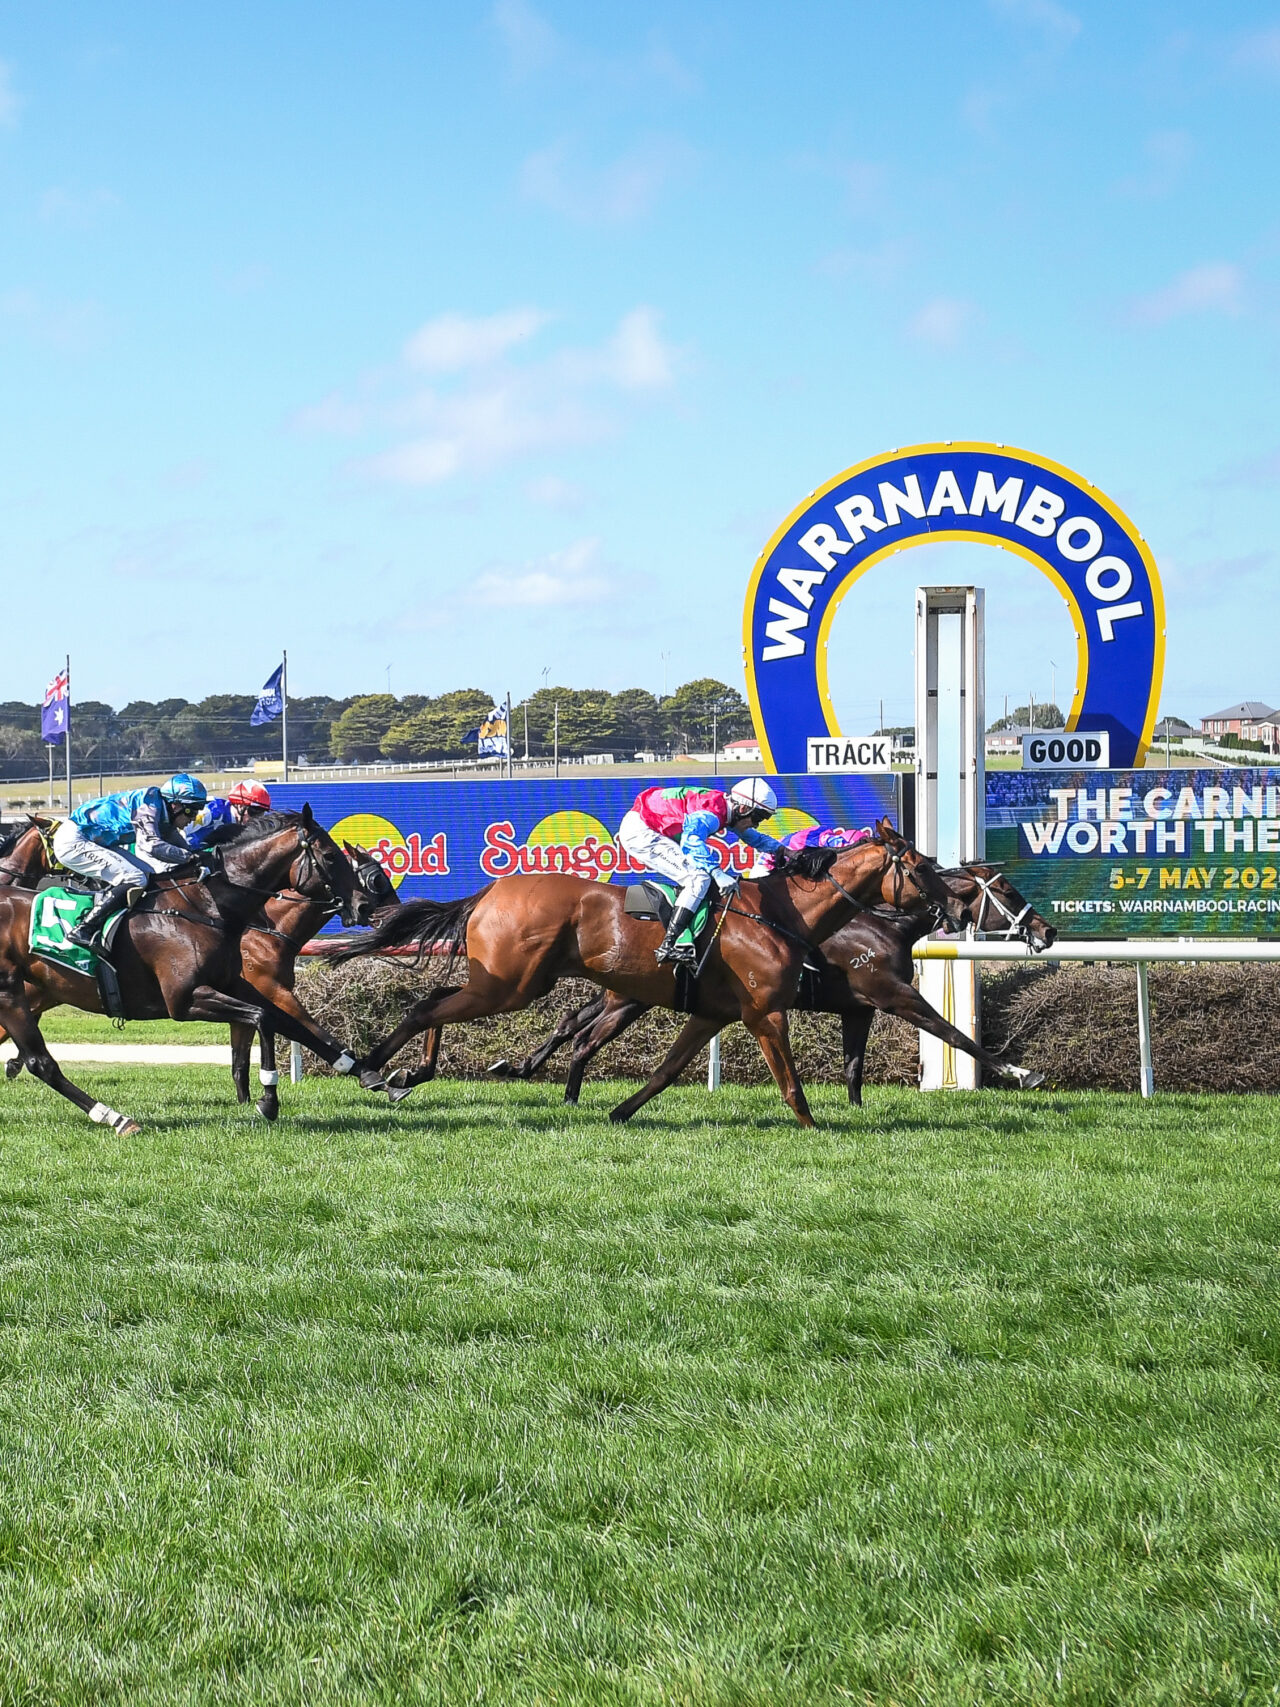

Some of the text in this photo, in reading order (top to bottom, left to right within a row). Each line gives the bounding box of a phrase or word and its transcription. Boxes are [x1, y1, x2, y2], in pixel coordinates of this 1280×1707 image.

[762, 470, 1144, 661] WARRNAMBOOL
[811, 743, 886, 765] TRACK
[1030, 739, 1101, 763] GOOD
[1049, 786, 1280, 821] THE CARNI
[1022, 821, 1280, 854] WORTH THE
[368, 832, 448, 879] gold
[1110, 867, 1280, 890] 5-7 MAY 202
[1051, 900, 1280, 912] TICKETS: WARRNAMBOOLRACIN
[850, 948, 876, 969] 204
